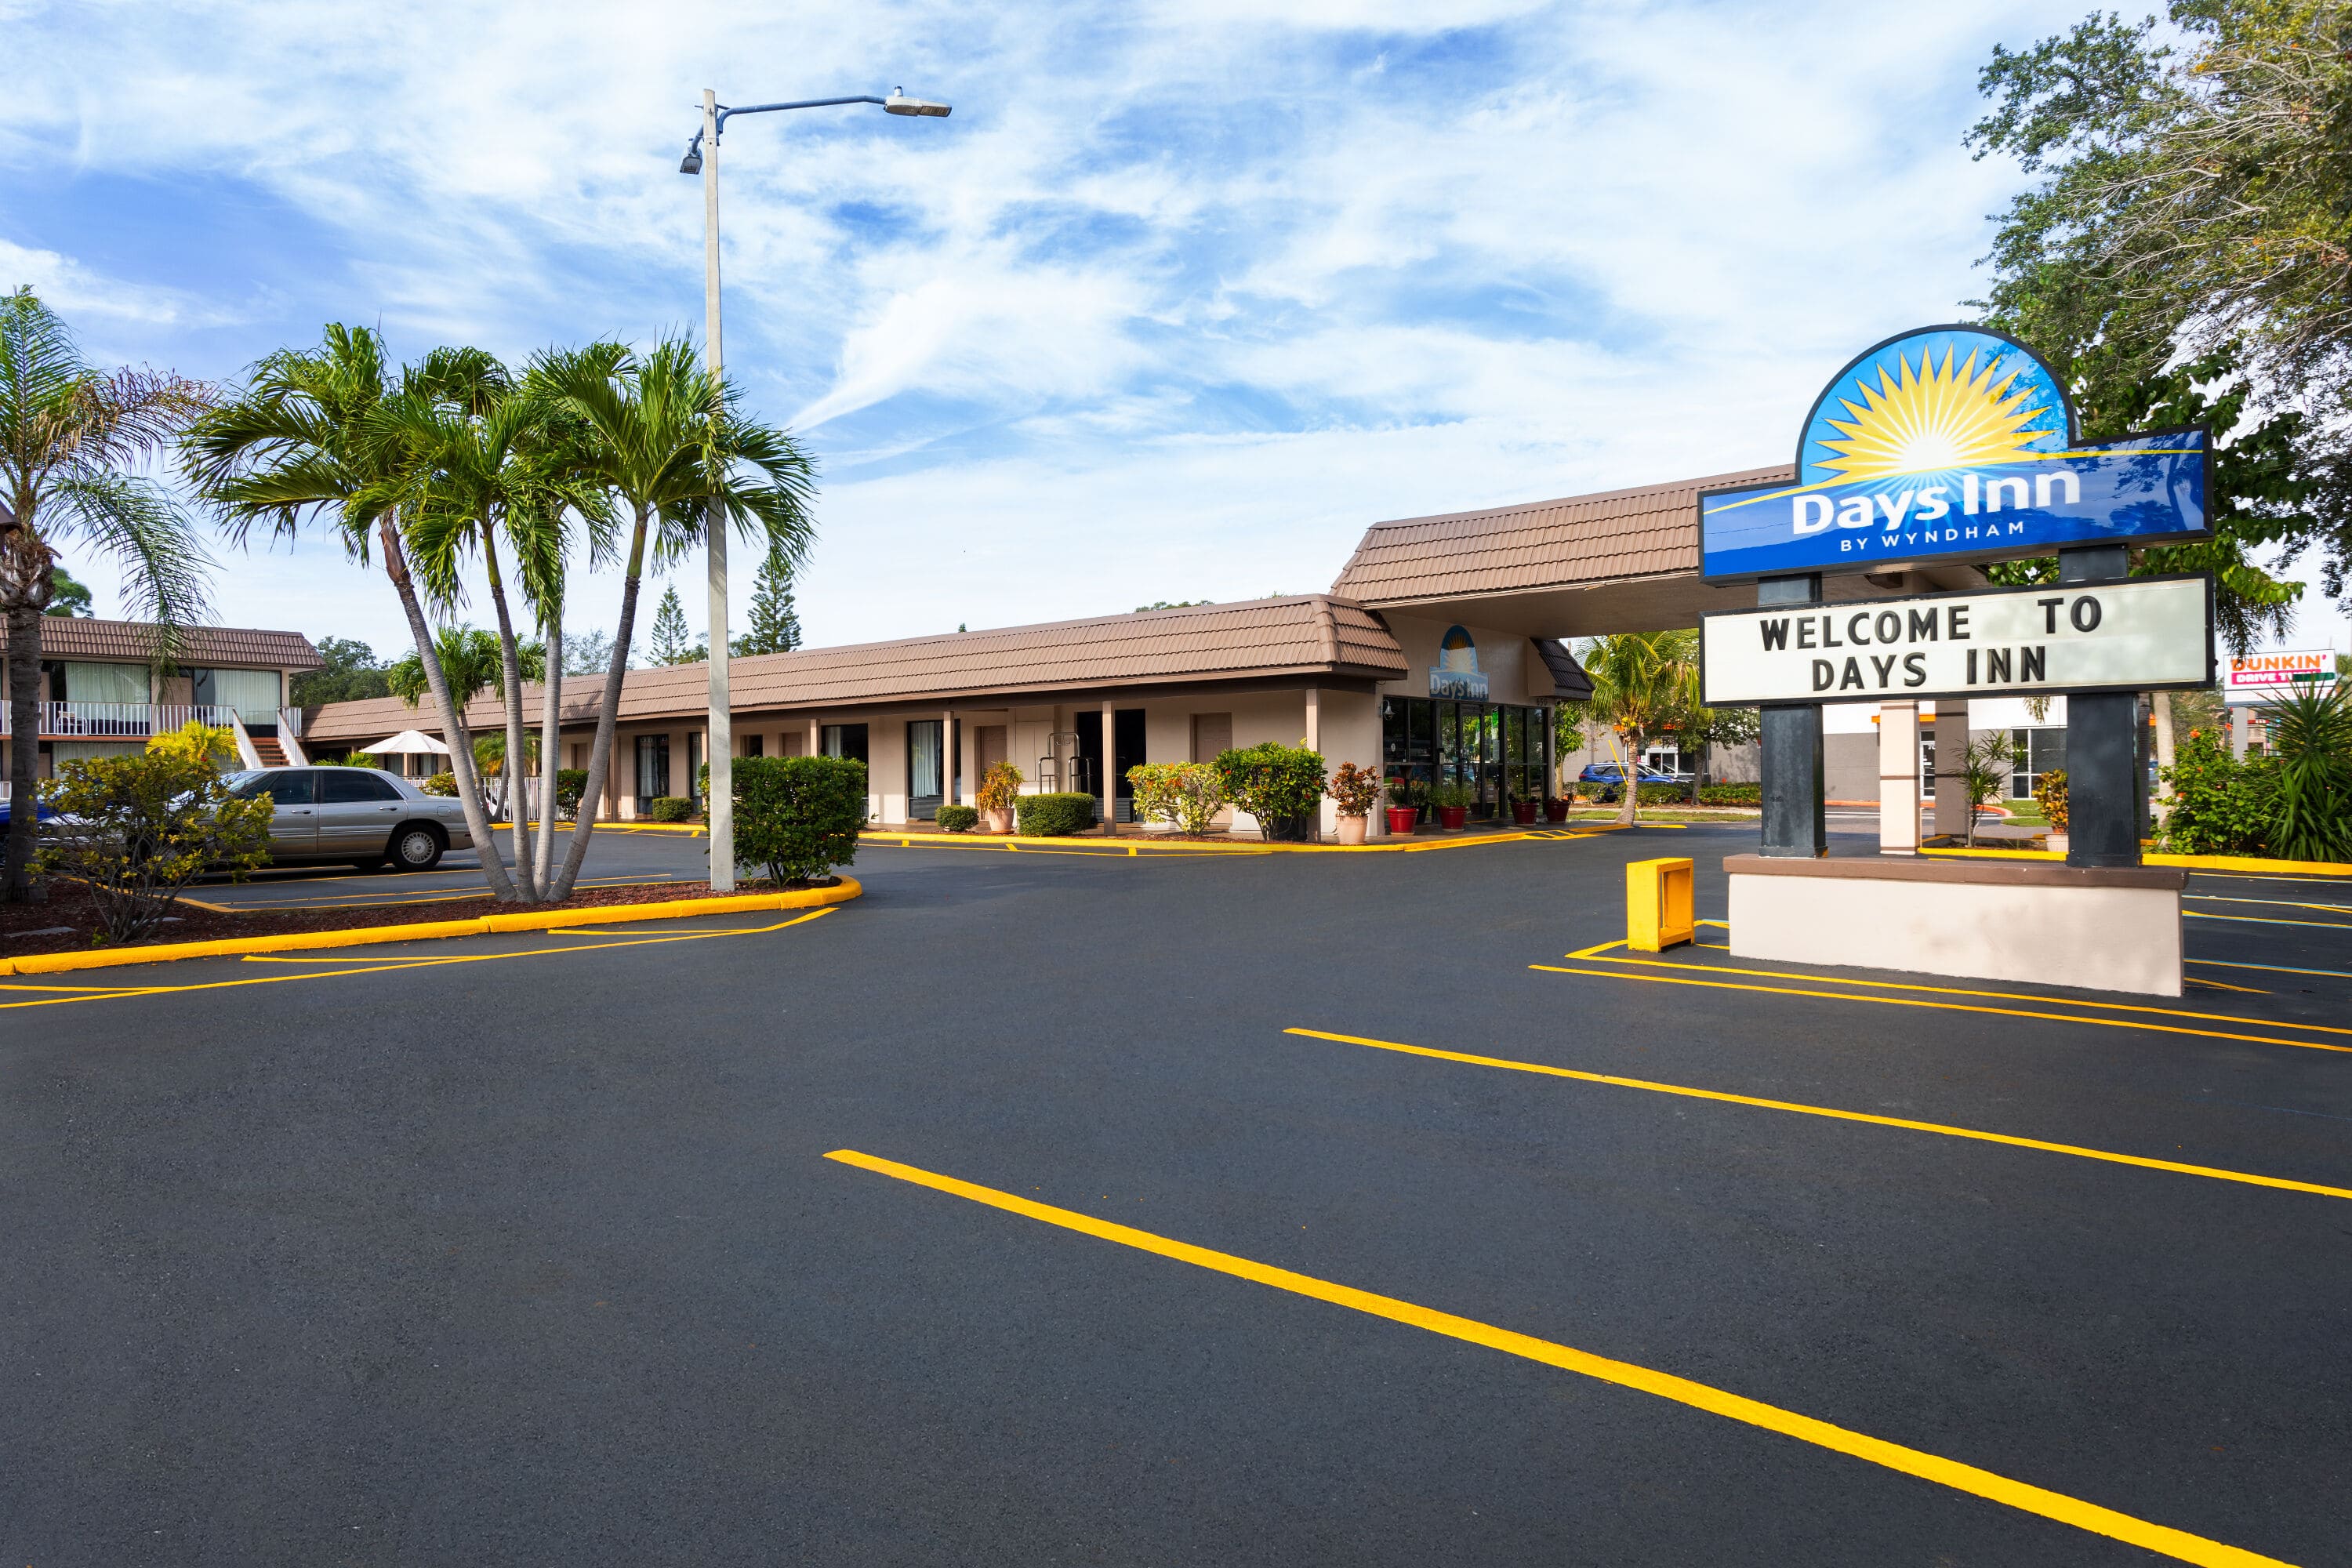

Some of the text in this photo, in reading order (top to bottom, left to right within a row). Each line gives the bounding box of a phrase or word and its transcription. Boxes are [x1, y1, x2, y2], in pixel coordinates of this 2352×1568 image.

[1793, 470, 2081, 535] Days Inn
[1841, 521, 2024, 551] BY WYNDHAM
[1760, 596, 2103, 651] WELCOME TO
[1813, 645, 2046, 691] DAYS INN
[2230, 654, 2327, 671] DUNKIN'
[2237, 672, 2278, 683] DRIVE
[1431, 674, 1488, 699] Days Inn
